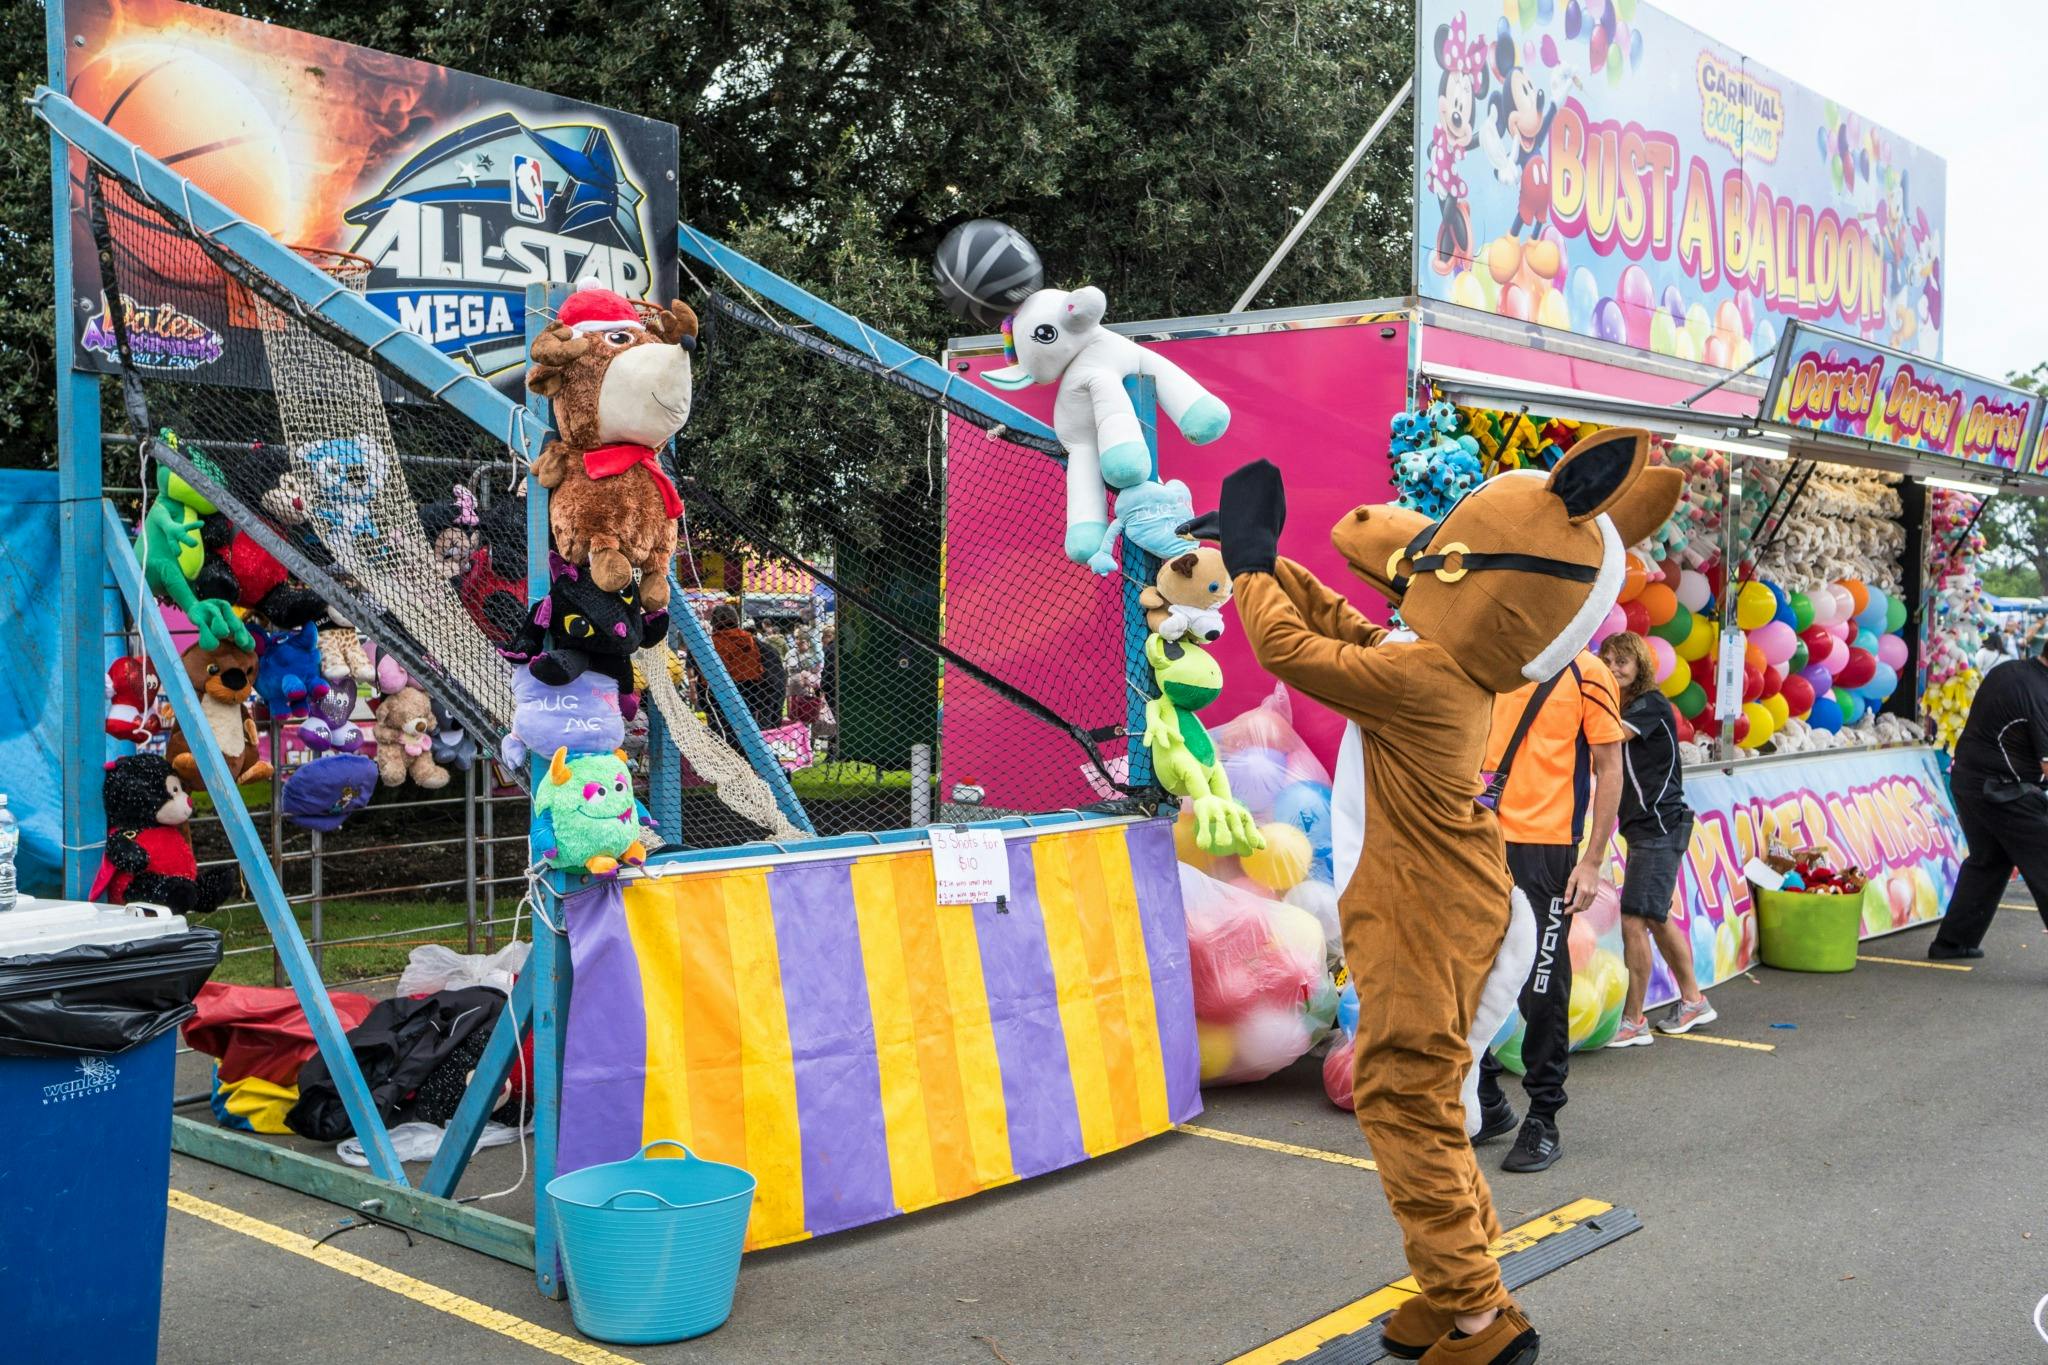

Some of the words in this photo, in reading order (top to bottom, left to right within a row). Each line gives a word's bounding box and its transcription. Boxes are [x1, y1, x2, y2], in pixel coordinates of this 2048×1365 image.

[1703, 65, 1777, 121] CARNIVAL
[1707, 97, 1772, 150] Kingdom
[520, 203, 537, 217] NBA
[1551, 104, 1676, 249] BUST
[1680, 163, 1716, 283] A
[1723, 176, 1885, 322] BALLOON
[397, 295, 514, 345] MEGA
[1790, 359, 1881, 414] Darts!
[1886, 370, 1959, 444] Darts!
[1965, 402, 2027, 452] Darts!
[564, 717, 603, 733] ME
[949, 833, 978, 849] Shots
[983, 833, 998, 849] for
[959, 855, 978, 870] $10
[1533, 897, 1564, 994] GIVOVA
[43, 1083, 117, 1105] WASTECORP
[44, 1071, 117, 1097] wanless
